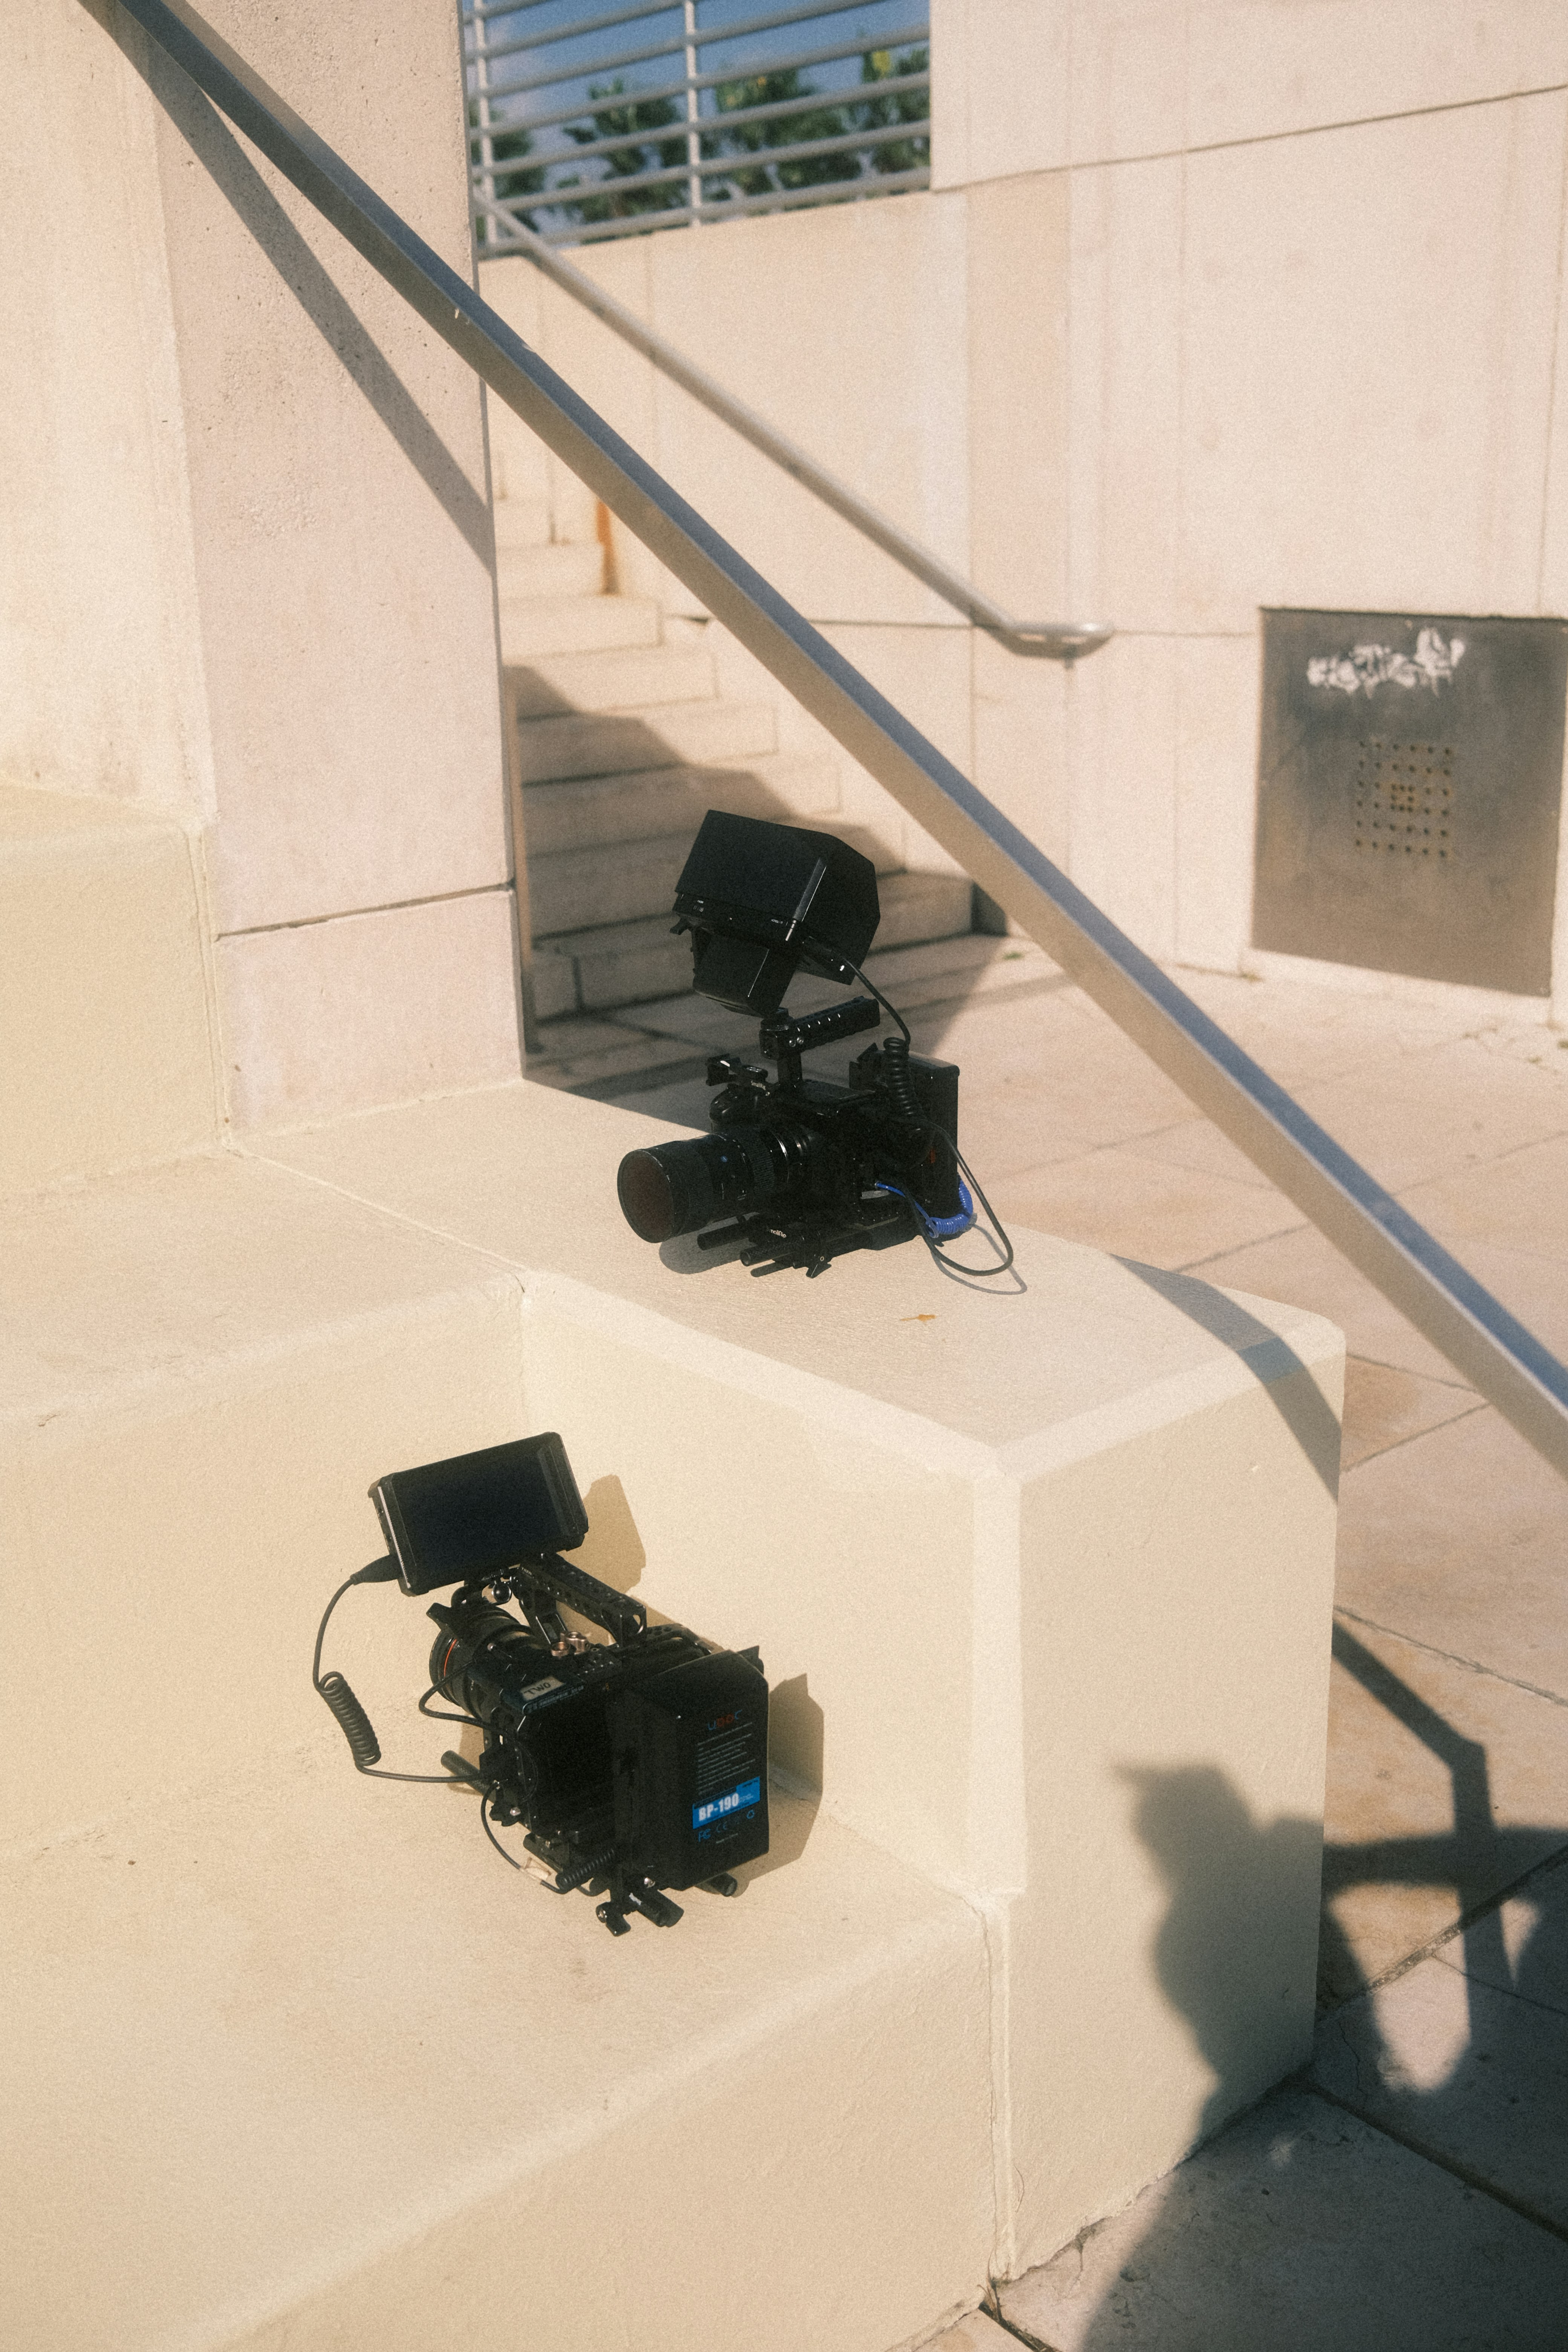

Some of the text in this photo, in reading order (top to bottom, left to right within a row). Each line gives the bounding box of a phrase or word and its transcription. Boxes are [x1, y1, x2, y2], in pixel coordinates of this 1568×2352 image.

[751, 1080, 766, 1090] SmallRig
[524, 1682, 551, 1694] TWO
[698, 1793, 738, 1822] BP-190
